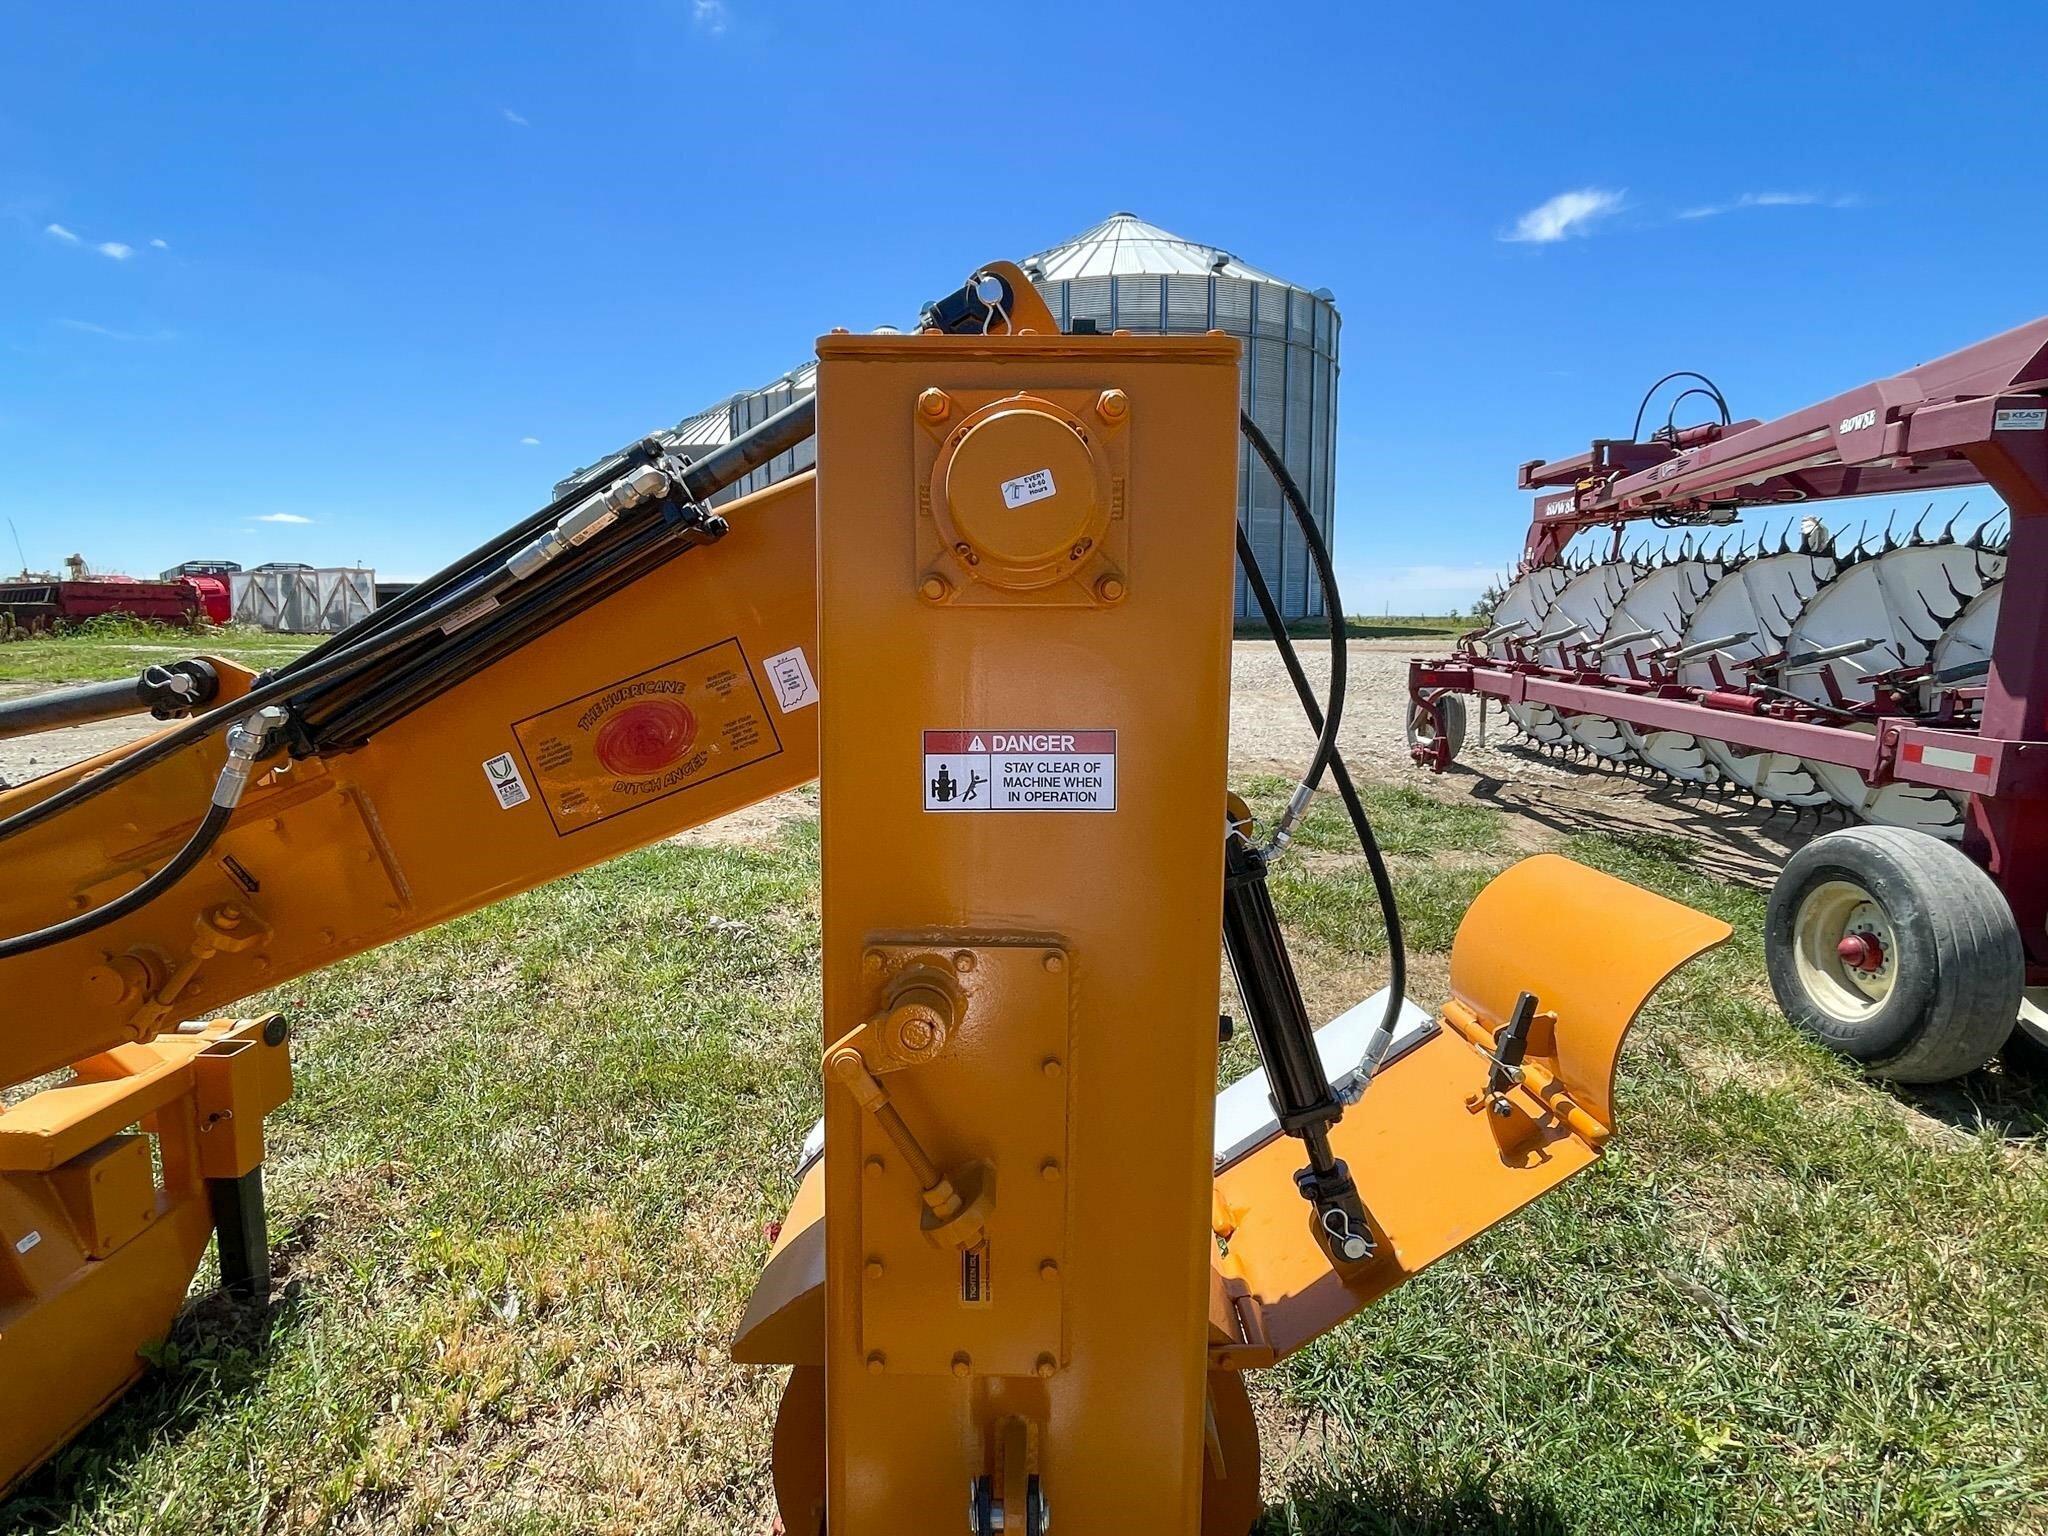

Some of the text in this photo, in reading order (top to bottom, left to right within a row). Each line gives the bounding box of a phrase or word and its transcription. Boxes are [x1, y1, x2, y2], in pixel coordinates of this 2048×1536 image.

[2012, 411, 2046, 419] KEAST
[1024, 472, 1045, 483] EVERY
[1029, 486, 1048, 495] Hours
[577, 680, 687, 731] THE HURRICANE
[992, 735, 1075, 752] DANGER
[1004, 762, 1101, 773] STAY CLEAR OF
[612, 777, 662, 795] DITCH
[1003, 777, 1102, 788] MACHINE WHEN
[499, 782, 520, 795] FEMA
[1008, 792, 1097, 802] IN OPERATION
